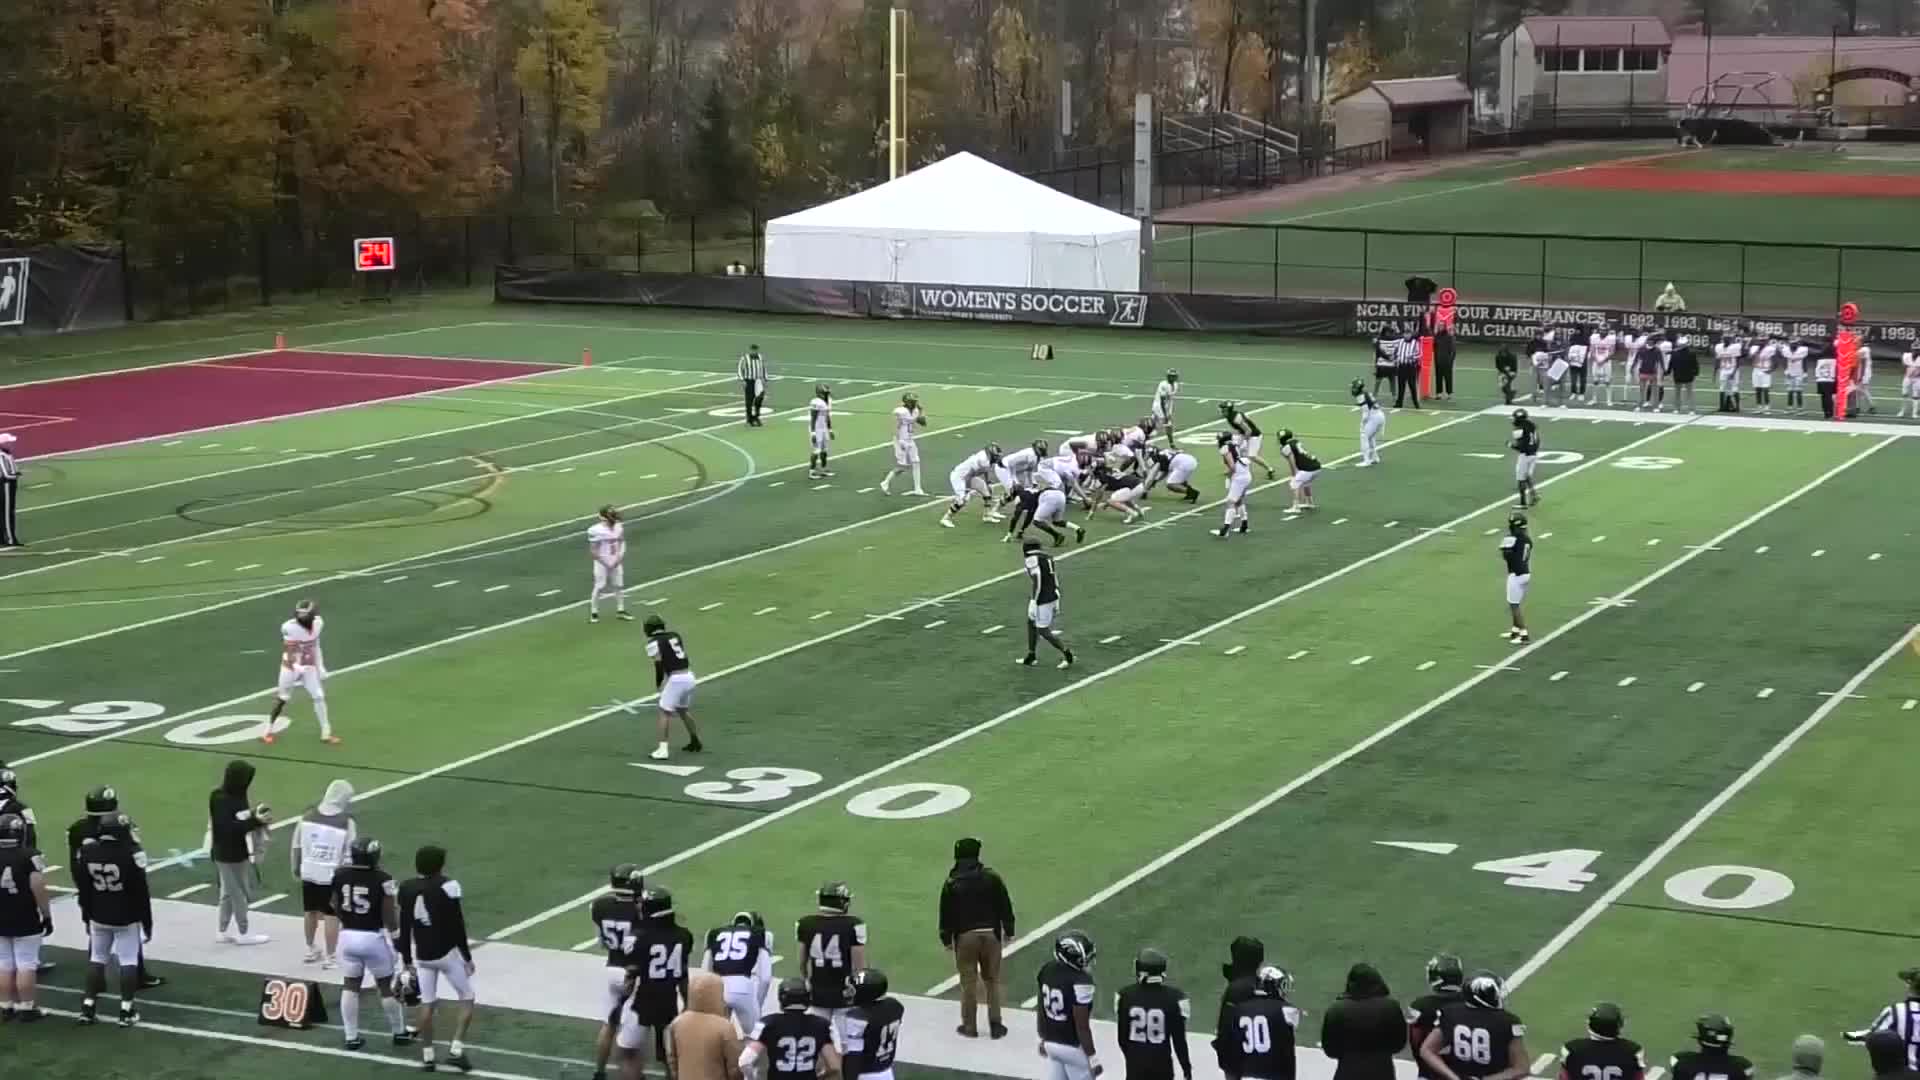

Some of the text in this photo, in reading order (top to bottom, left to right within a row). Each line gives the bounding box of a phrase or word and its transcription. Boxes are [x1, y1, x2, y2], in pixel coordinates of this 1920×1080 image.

[360, 243, 388, 265] 24
[919, 289, 1106, 314] WOMEN'S SOCCER
[1356, 303, 1400, 318] NCAA
[1403, 304, 1446, 318] FIN
[1493, 307, 1606, 324] APPEARANCES
[1356, 320, 1400, 334] NCAA
[1032, 343, 1049, 360] 10
[667, 637, 685, 660] 5
[87, 862, 123, 892] 52
[341, 883, 370, 915] 15
[413, 894, 432, 926] 4
[602, 919, 634, 950] 57
[714, 931, 753, 961] 35
[649, 943, 684, 979] 24
[809, 933, 843, 968] 44
[262, 978, 309, 1024] 30
[1128, 1007, 1166, 1045] 28
[1239, 1014, 1271, 1054] 30
[776, 1036, 817, 1072] 32
[1453, 1023, 1490, 1065] 68
